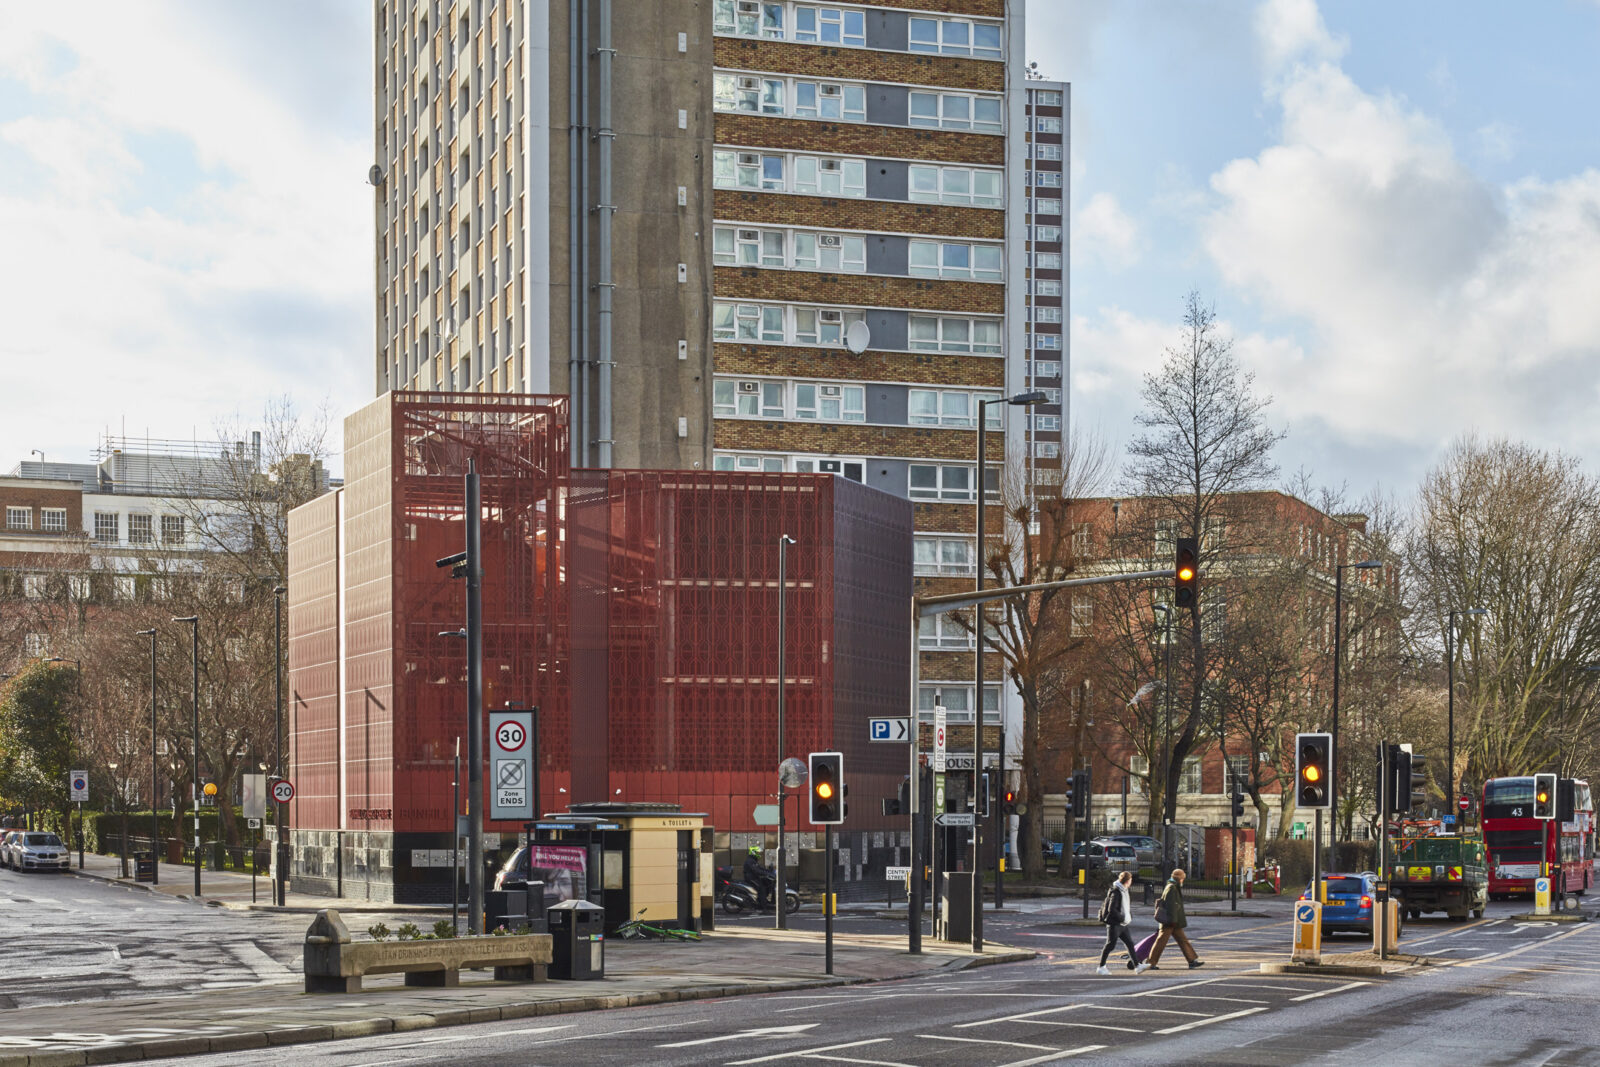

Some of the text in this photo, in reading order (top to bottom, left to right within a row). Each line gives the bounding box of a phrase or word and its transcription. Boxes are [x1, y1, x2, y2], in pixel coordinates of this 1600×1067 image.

[876, 722, 886, 738] P
[500, 730, 522, 742] 30
[945, 758, 975, 768] OUSE
[276, 786, 292, 796] 20
[1512, 808, 1522, 816] 43
